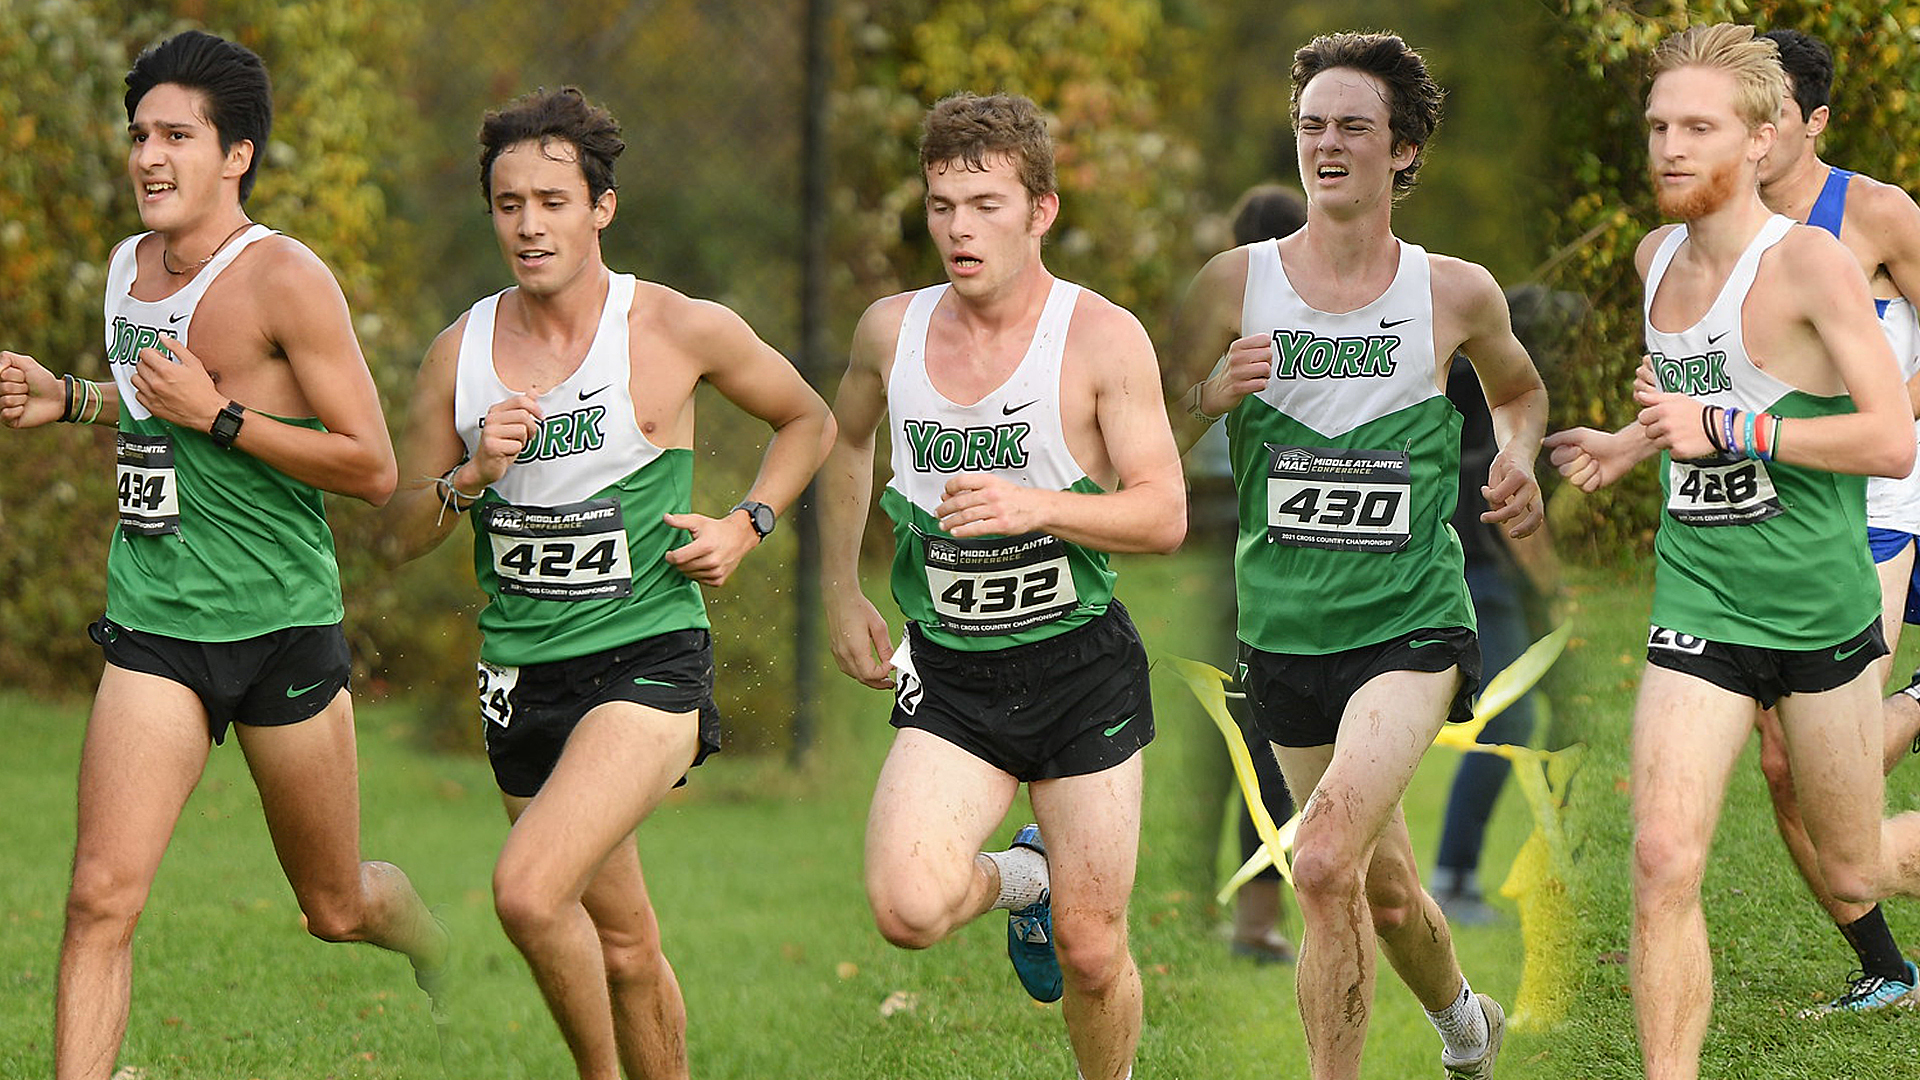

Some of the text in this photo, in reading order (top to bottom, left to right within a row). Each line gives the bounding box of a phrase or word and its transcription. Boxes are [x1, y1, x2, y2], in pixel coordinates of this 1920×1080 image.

[1273, 329, 1402, 379] YORK
[479, 405, 606, 464] ORK
[904, 419, 1031, 473] YORK
[1278, 460, 1310, 471] MAC
[1313, 457, 1404, 469] MIDDLE ATLANTIC
[118, 472, 167, 511] 434
[1679, 464, 1758, 503] 428
[525, 507, 616, 524] MIDDLE ATLANTIC
[1278, 487, 1403, 527] 430
[492, 517, 522, 528] MAC
[960, 535, 1054, 558] MIDDLE ATLANTIC
[1296, 534, 1316, 542] CROSS
[1316, 536, 1345, 544] COUNTRY
[1345, 538, 1394, 546] CHAMPIONSHIP
[500, 539, 618, 577] 424
[930, 549, 956, 563] MAC
[568, 585, 618, 596] CHAMPIONSHIP
[941, 567, 1060, 614] 432
[960, 623, 980, 631] CROSS
[981, 622, 1012, 631] COUNTRY
[1012, 611, 1063, 628] CHAMPIONSHIP
